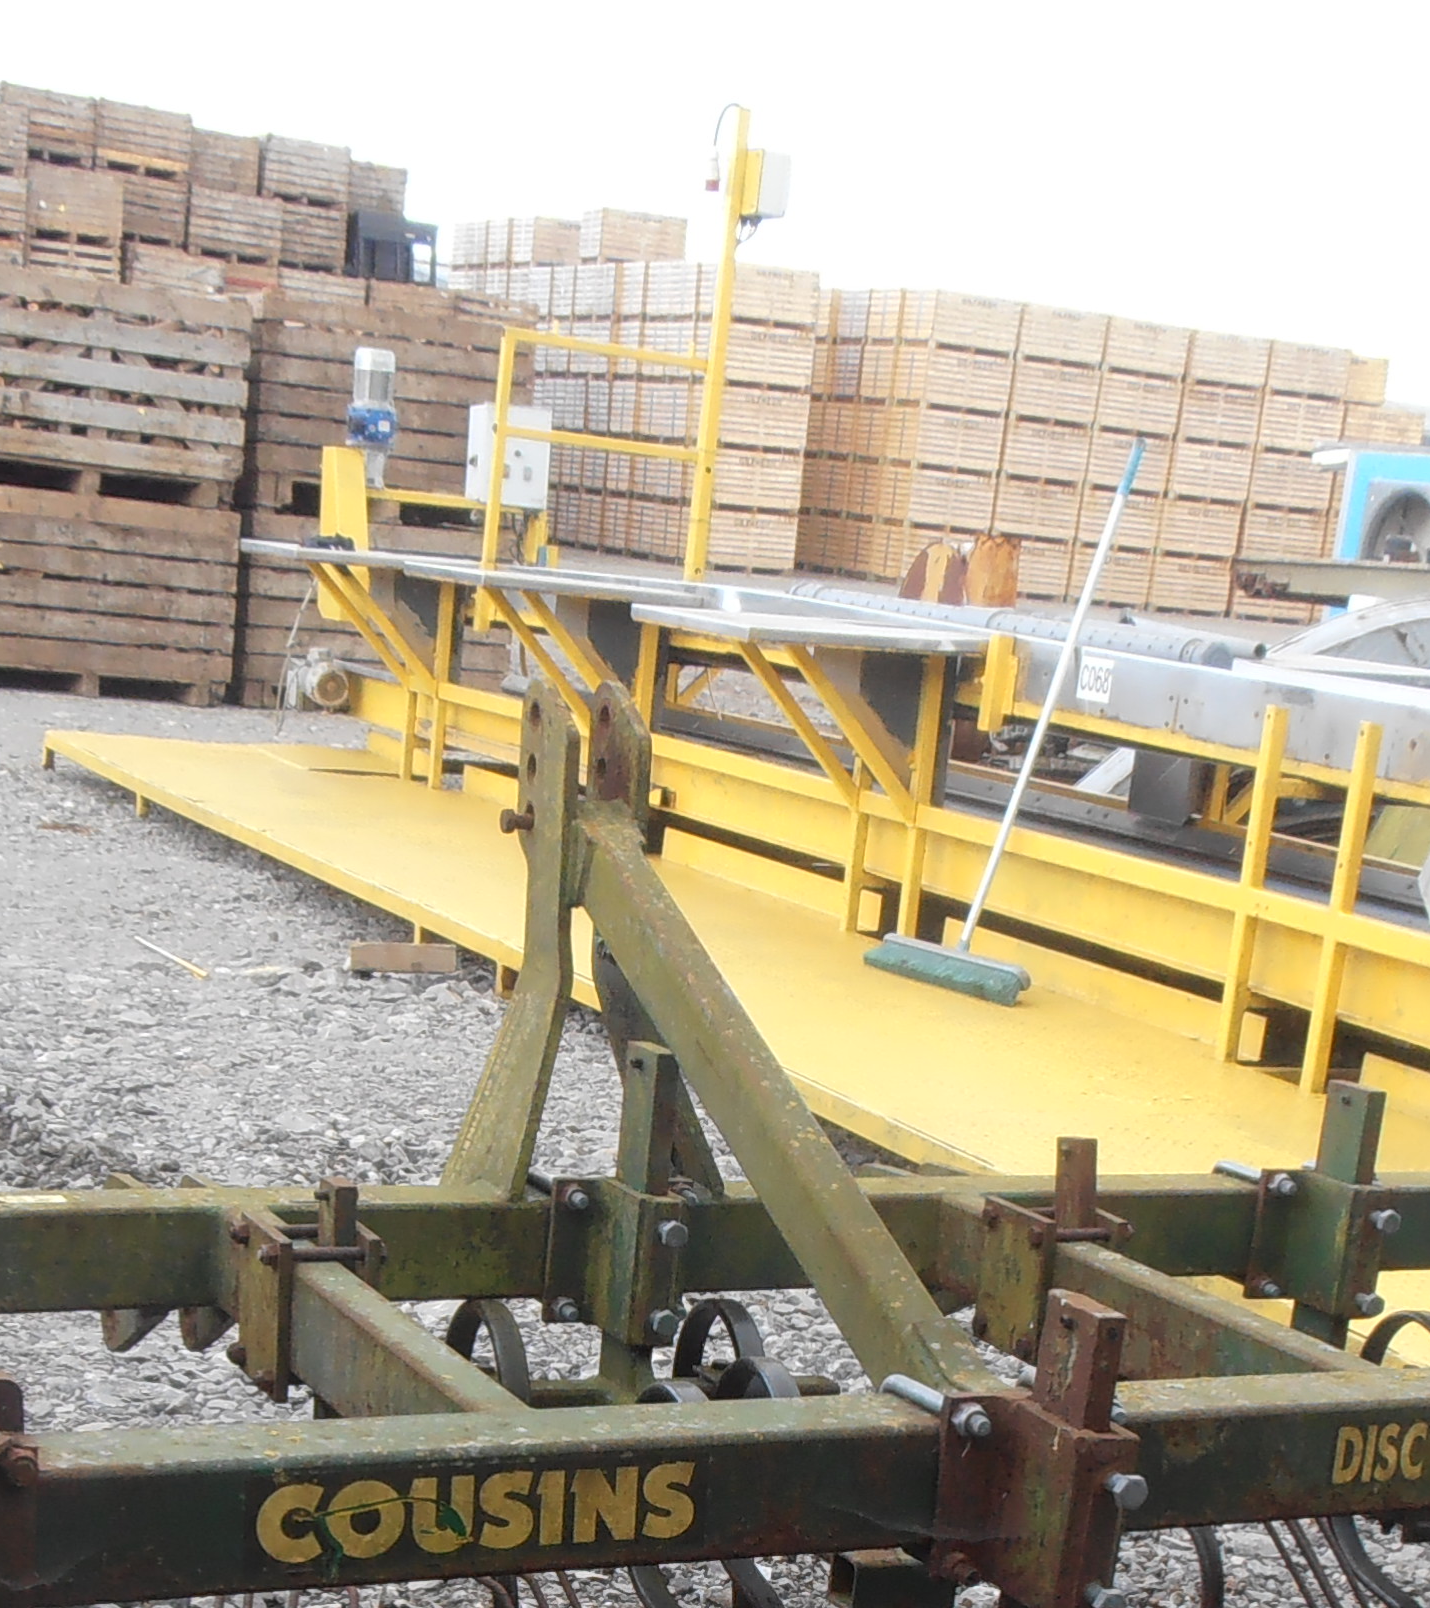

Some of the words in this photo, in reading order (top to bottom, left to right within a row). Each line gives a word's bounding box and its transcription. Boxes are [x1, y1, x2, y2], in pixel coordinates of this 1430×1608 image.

[1079, 663, 1112, 695] C068
[1331, 1421, 1429, 1485] DISC
[256, 1460, 696, 1564] COUSINS
